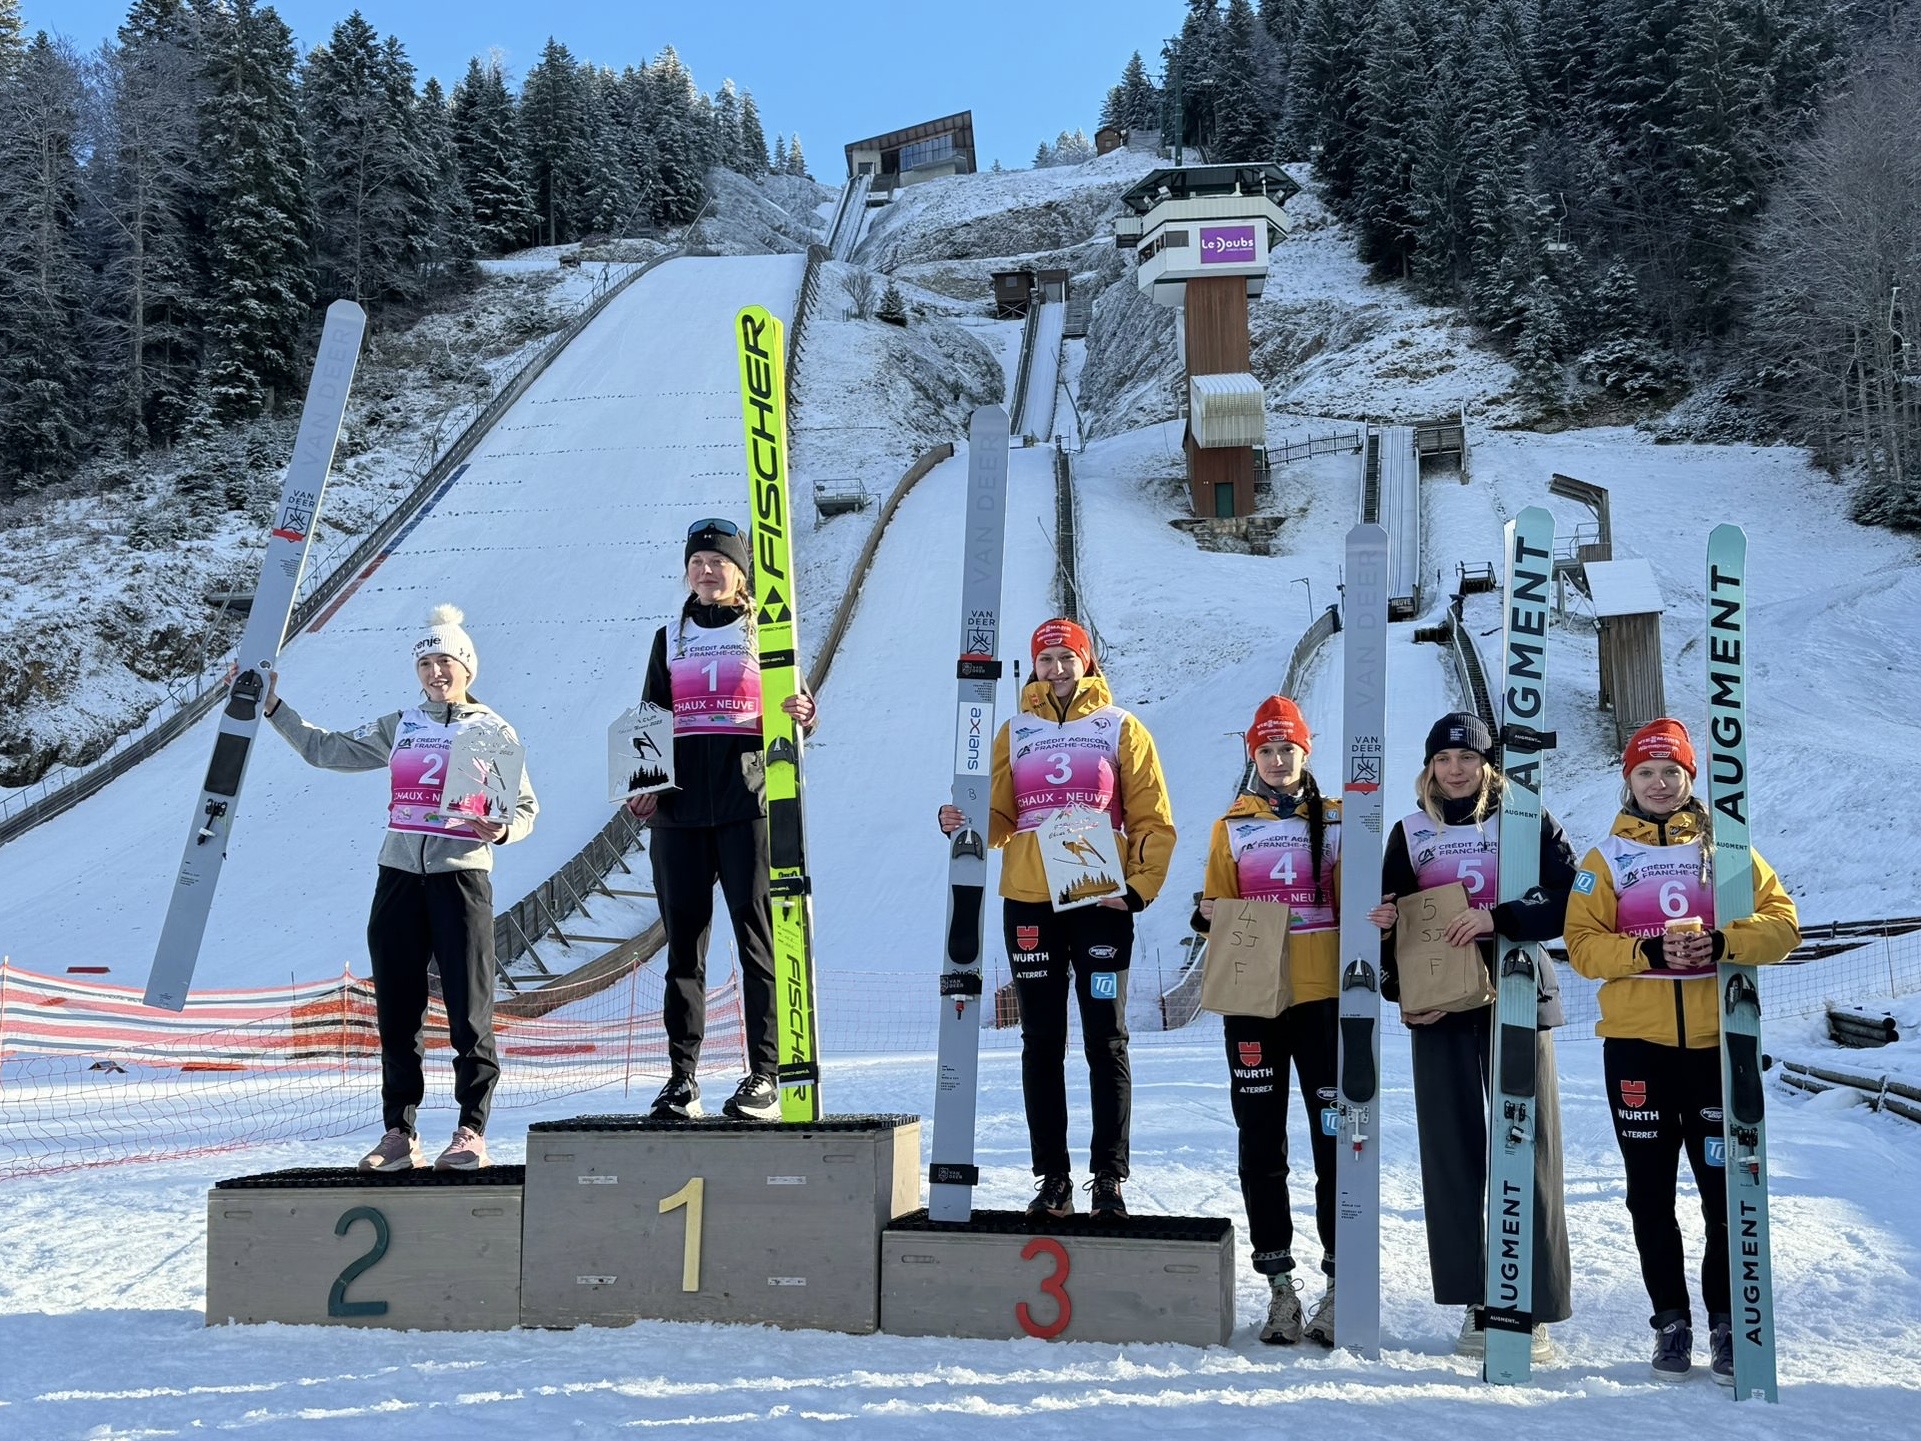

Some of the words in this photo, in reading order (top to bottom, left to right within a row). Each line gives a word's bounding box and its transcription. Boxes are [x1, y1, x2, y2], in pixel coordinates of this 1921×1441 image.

[1202, 239, 1214, 249] Le
[1216, 237, 1254, 253] Doubs
[742, 314, 784, 580] FISCHER
[288, 496, 316, 508] DEER
[293, 490, 315, 500] VAN
[968, 617, 996, 626] DEER
[971, 610, 993, 618] VAN
[701, 660, 718, 692] 1
[1504, 536, 1549, 796] AGMENT
[674, 701, 707, 713] CHAUX
[716, 700, 754, 711] NEUVE
[1710, 564, 1746, 826] AUGMENT
[967, 707, 981, 771] axians
[1352, 744, 1381, 752] DEER
[418, 753, 443, 785] 2
[1044, 752, 1073, 785] 3
[1018, 793, 1054, 808] CHAUX
[1066, 792, 1110, 804] NEUVE
[1504, 808, 1538, 819] AUGMENT
[1716, 841, 1748, 850] AUGMENT
[1269, 852, 1297, 885] 4
[1457, 859, 1484, 894] 5
[1641, 863, 1674, 872] CRÉDIT
[1422, 898, 1436, 921] 5
[1659, 880, 1689, 918] 6
[1238, 902, 1257, 928] 4
[1023, 970, 1048, 979] TERREX
[1235, 962, 1247, 985] F
[1430, 958, 1443, 976] F
[1095, 976, 1113, 993] TQ
[1246, 1084, 1274, 1094] TERREX
[1628, 1130, 1658, 1139] TERREX
[658, 1177, 704, 1293] 1
[1500, 1180, 1522, 1312] UGMENT
[327, 1205, 389, 1318] 2
[1740, 1200, 1763, 1347] AUGMENT
[1015, 1236, 1072, 1339] 3
